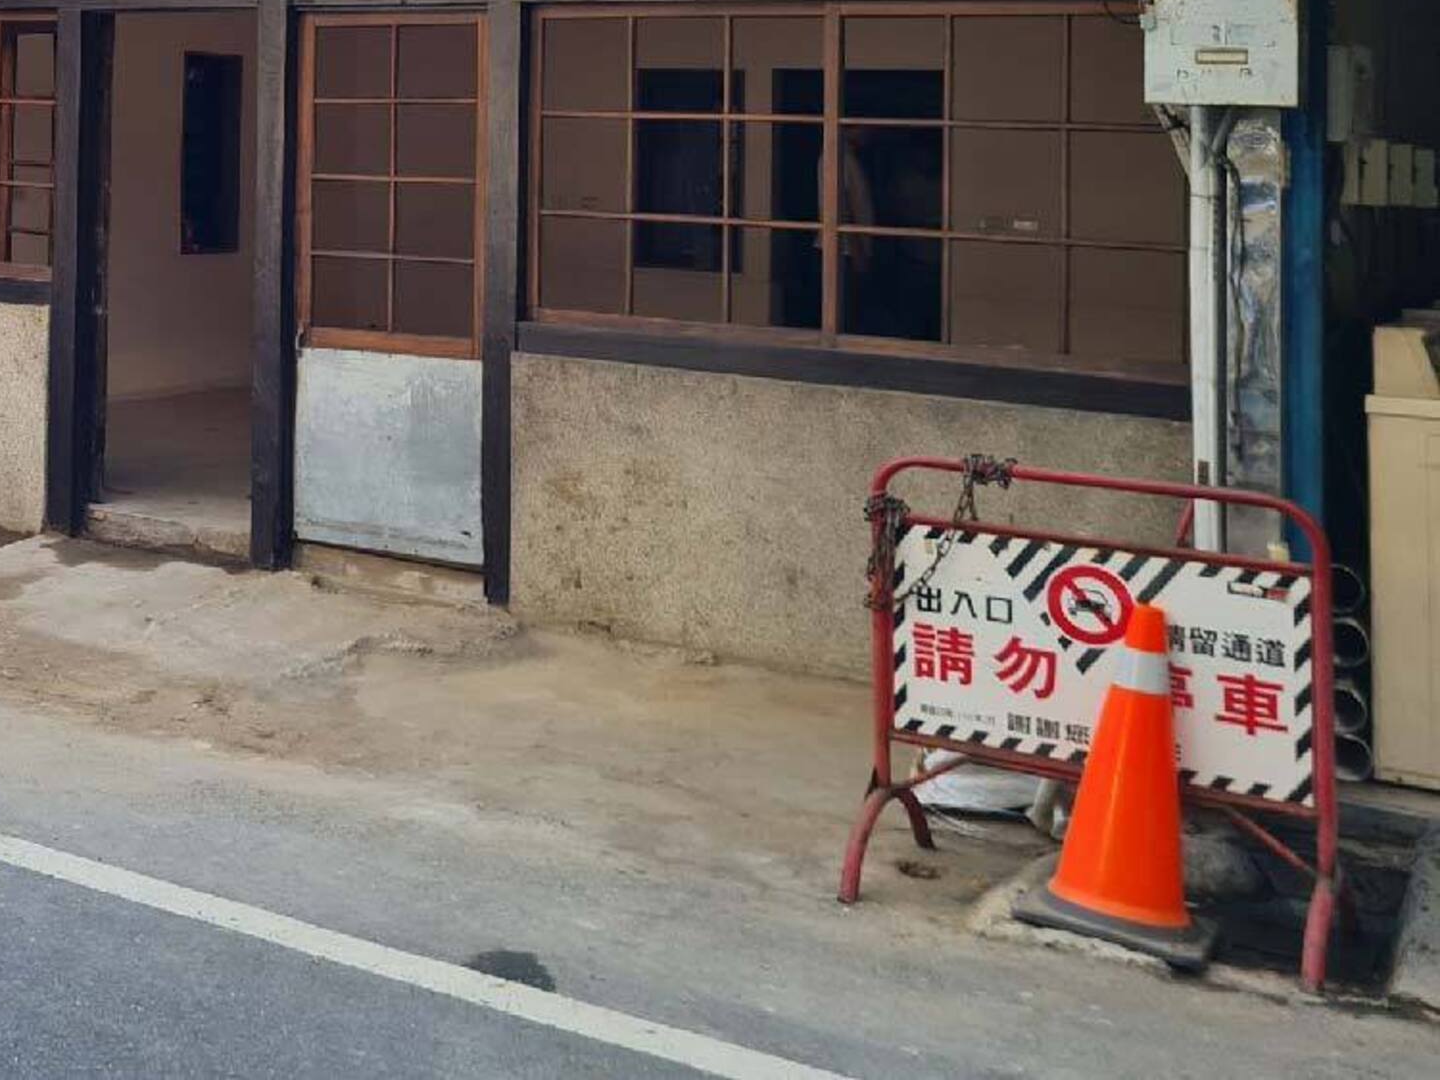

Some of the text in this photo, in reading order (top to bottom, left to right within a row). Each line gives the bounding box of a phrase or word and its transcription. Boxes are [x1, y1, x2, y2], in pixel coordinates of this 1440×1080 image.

[916, 586, 1013, 623] 出入口
[912, 622, 1058, 700] 請勿
